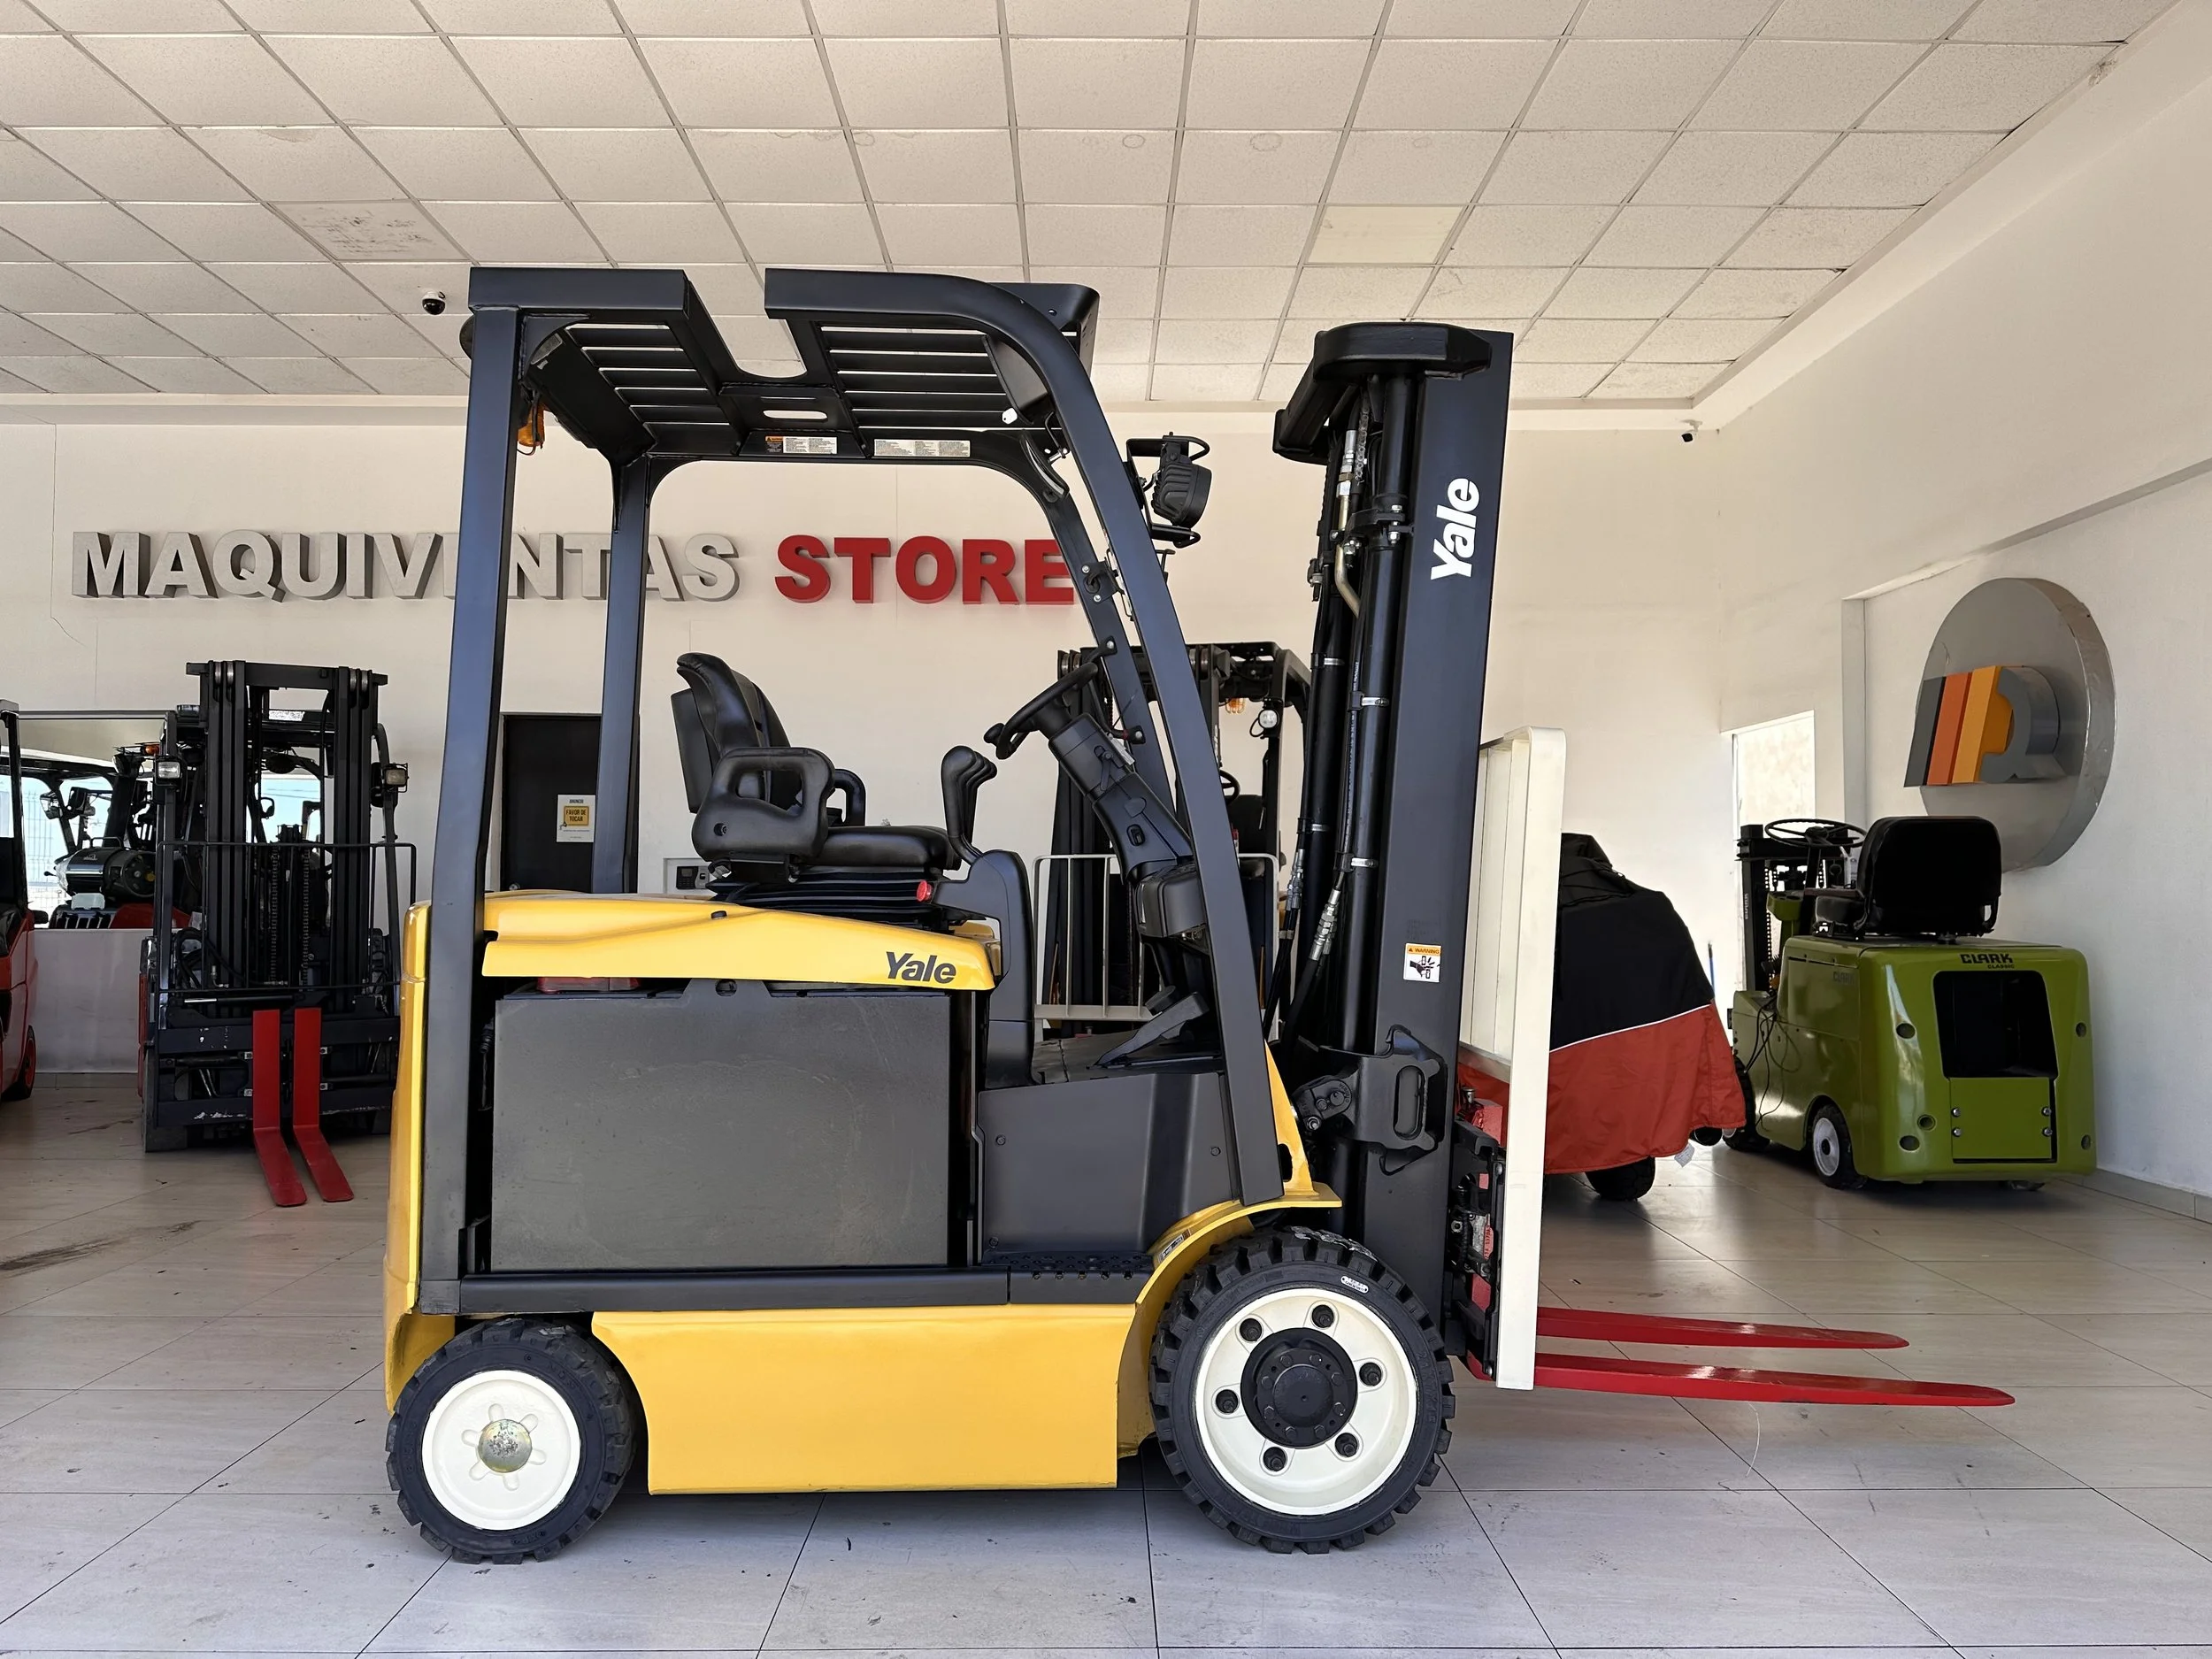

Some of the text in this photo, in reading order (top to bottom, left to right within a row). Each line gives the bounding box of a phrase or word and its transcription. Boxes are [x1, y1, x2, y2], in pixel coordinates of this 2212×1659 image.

[1430, 478, 1480, 580] Yale
[72, 528, 1075, 605] MAQUIVNTAS STORE
[886, 951, 956, 984] Yale
[1959, 953, 2014, 964] CLARK
